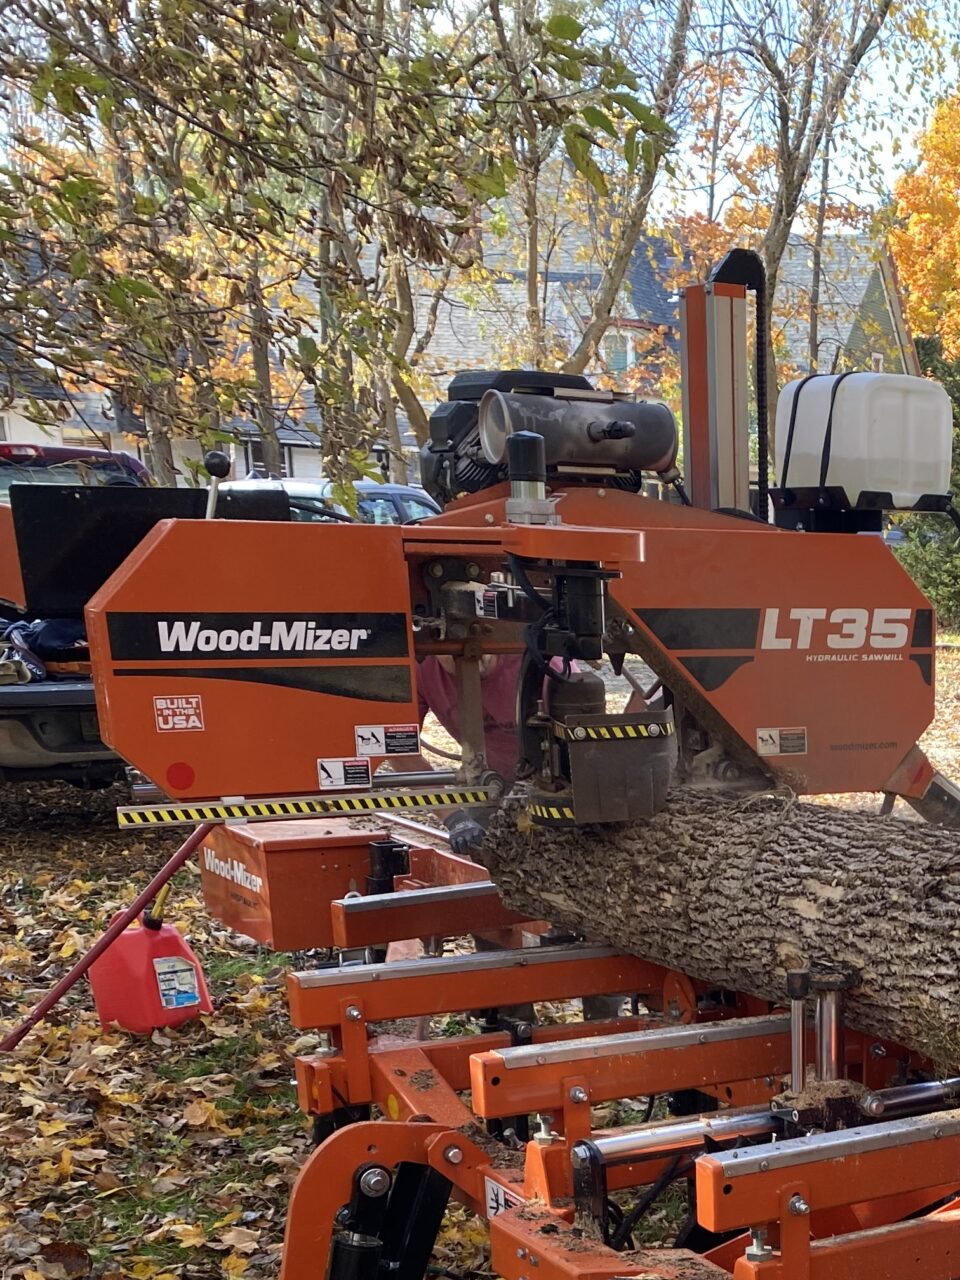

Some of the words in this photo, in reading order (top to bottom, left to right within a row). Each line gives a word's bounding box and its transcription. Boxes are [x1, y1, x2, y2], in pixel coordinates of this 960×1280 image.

[157, 621, 369, 652] Wood-Mizer
[761, 608, 912, 649] LT35
[156, 698, 198, 709] BUILT
[158, 715, 202, 729] USA
[203, 846, 263, 893] Wood-Mizer
